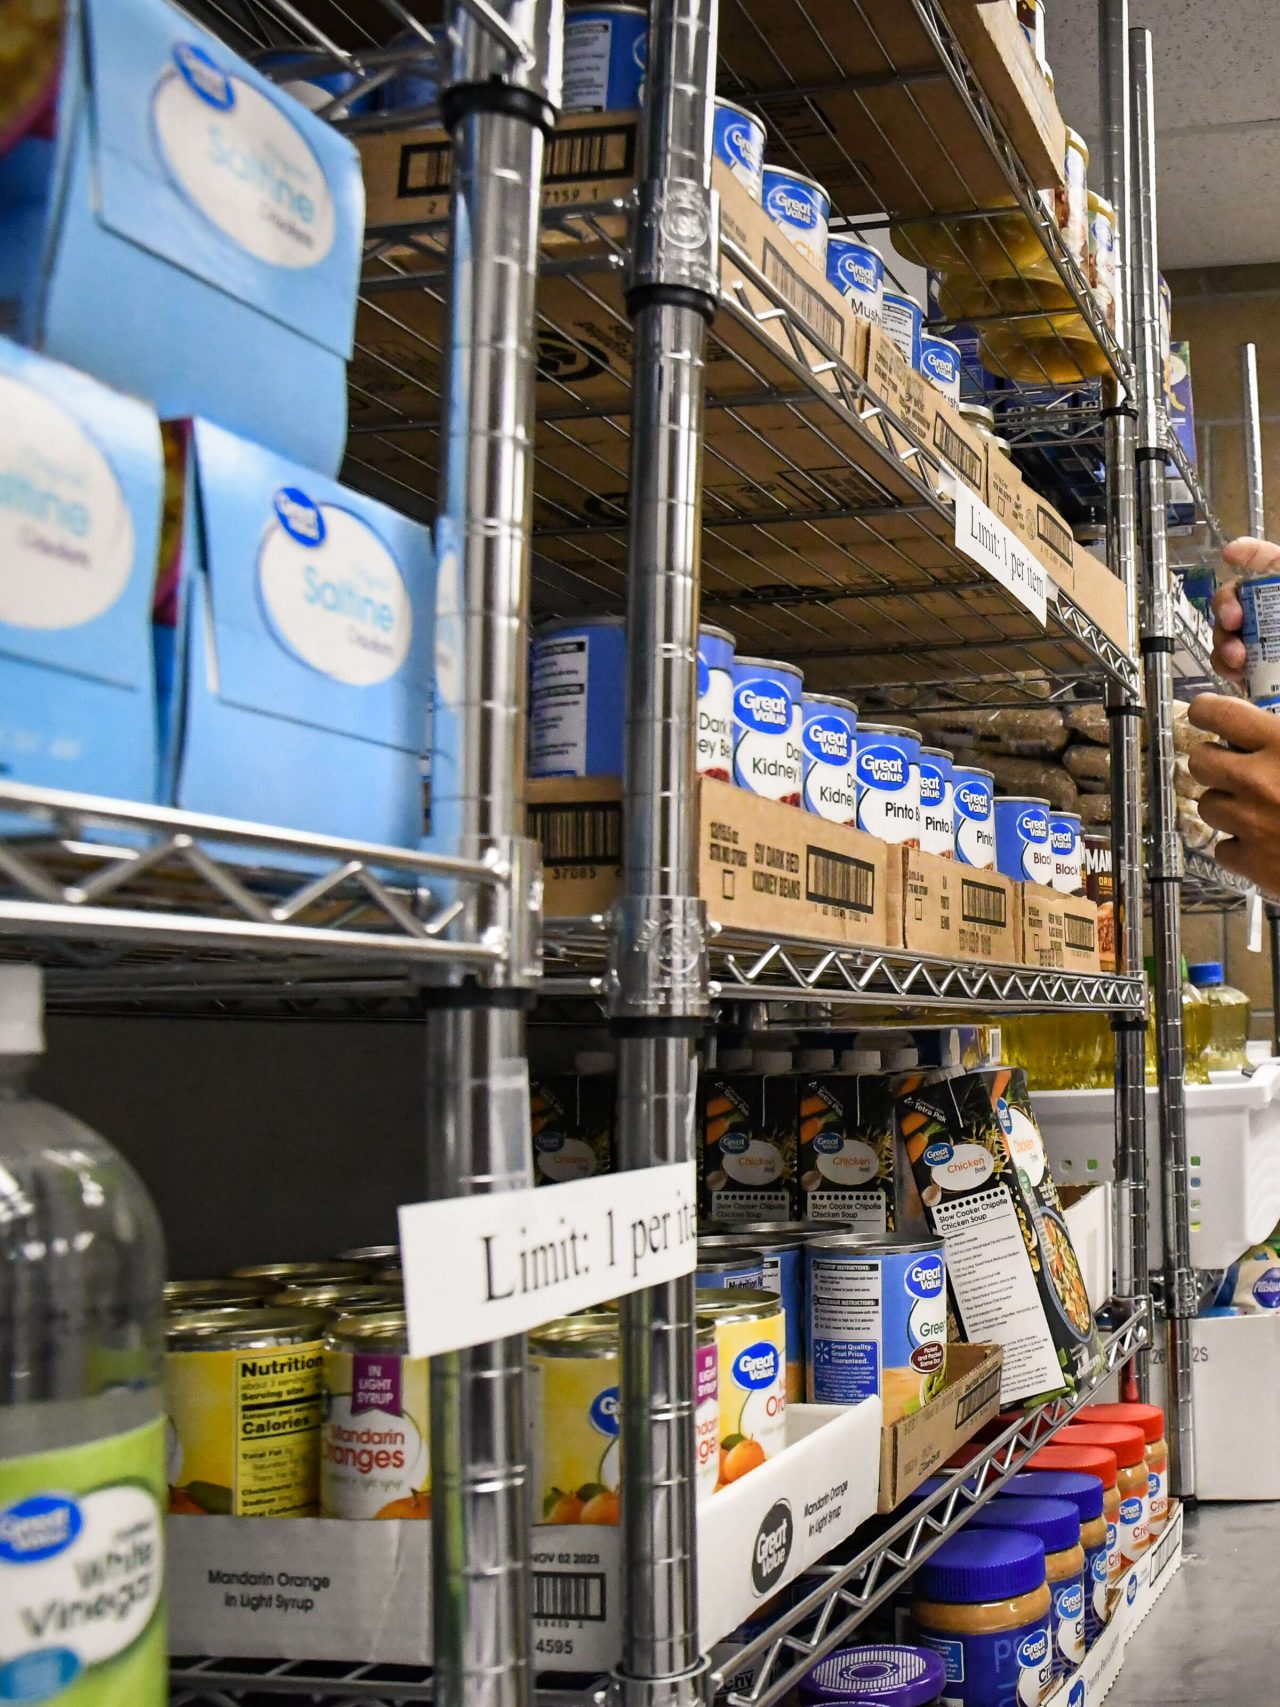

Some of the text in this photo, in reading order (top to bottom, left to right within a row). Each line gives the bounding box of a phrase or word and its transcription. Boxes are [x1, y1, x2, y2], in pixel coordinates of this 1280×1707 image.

[774, 192, 813, 216] Great
[783, 207, 812, 225] Value
[844, 258, 875, 281] Great
[852, 270, 875, 287] Value
[927, 353, 953, 371] Great
[934, 363, 953, 378] Value
[970, 504, 1001, 561] Limit:
[1010, 551, 1025, 581] per
[1026, 557, 1044, 599] item
[738, 689, 787, 714] Great
[752, 708, 787, 726] Value
[808, 724, 848, 747] Great
[820, 741, 849, 759] Value
[751, 756, 798, 785] Kidney
[860, 753, 904, 774] Great
[871, 767, 904, 783] Value
[959, 788, 988, 805] Great
[884, 801, 914, 821] Pinto
[968, 800, 988, 815] Value
[924, 816, 950, 834] Pinto
[1022, 816, 1047, 832] Great
[1030, 826, 1047, 839] Value
[1051, 839, 1072, 850] Value
[1055, 863, 1079, 876] Black
[816, 1088, 832, 1106] Tetra
[913, 1101, 948, 1124] Tetra Pak
[723, 1137, 745, 1147] Great
[817, 1136, 839, 1147] Great
[738, 1156, 775, 1167] Chicken
[832, 1155, 870, 1167] Chicken
[926, 1147, 949, 1160] Great
[946, 1156, 985, 1174] Chicken
[716, 1202, 733, 1210] Slow
[734, 1202, 758, 1210] Cooker
[716, 1210, 762, 1219] Chicken Soup
[811, 1202, 882, 1212] Slow Cooker Chipotle
[811, 1210, 858, 1219] Chicken Soup
[938, 1198, 1009, 1224] Slow Cooker Chipotle
[941, 1213, 988, 1232] Chicken Soup
[481, 1216, 590, 1302] Limit:
[606, 1209, 616, 1267] 1
[630, 1210, 671, 1278] per
[911, 1265, 942, 1283] Great
[919, 1278, 942, 1291] Value
[831, 1343, 874, 1352] Great Quality.
[241, 1353, 324, 1378] Nutrition
[738, 1351, 776, 1373] Great
[831, 1357, 869, 1365] Guaranteed.
[919, 1360, 933, 1368] Same
[367, 1364, 383, 1378] IN
[749, 1366, 776, 1382] Value
[241, 1385, 305, 1402] Serving size
[358, 1378, 393, 1392] LIGHT
[356, 1391, 395, 1405] SYRUP
[241, 1413, 311, 1436] Calories
[267, 1448, 283, 1459] Fat
[803, 1479, 849, 1519] Mandarin Orange
[1119, 1502, 1141, 1517] Great
[814, 1511, 829, 1535] Light
[828, 1504, 843, 1525] Syrup
[755, 1518, 788, 1563] Great
[72, 1540, 154, 1590] White
[573, 1553, 600, 1565] 2023
[761, 1546, 786, 1578] Value
[207, 1569, 331, 1592] Mandarin Orange
[18, 1572, 152, 1639] Vinegar
[239, 1593, 273, 1612] Light
[275, 1593, 315, 1613] Syrup
[1062, 1592, 1081, 1608] Great
[534, 1639, 575, 1655] 4595
[1022, 1636, 1046, 1657] Great
